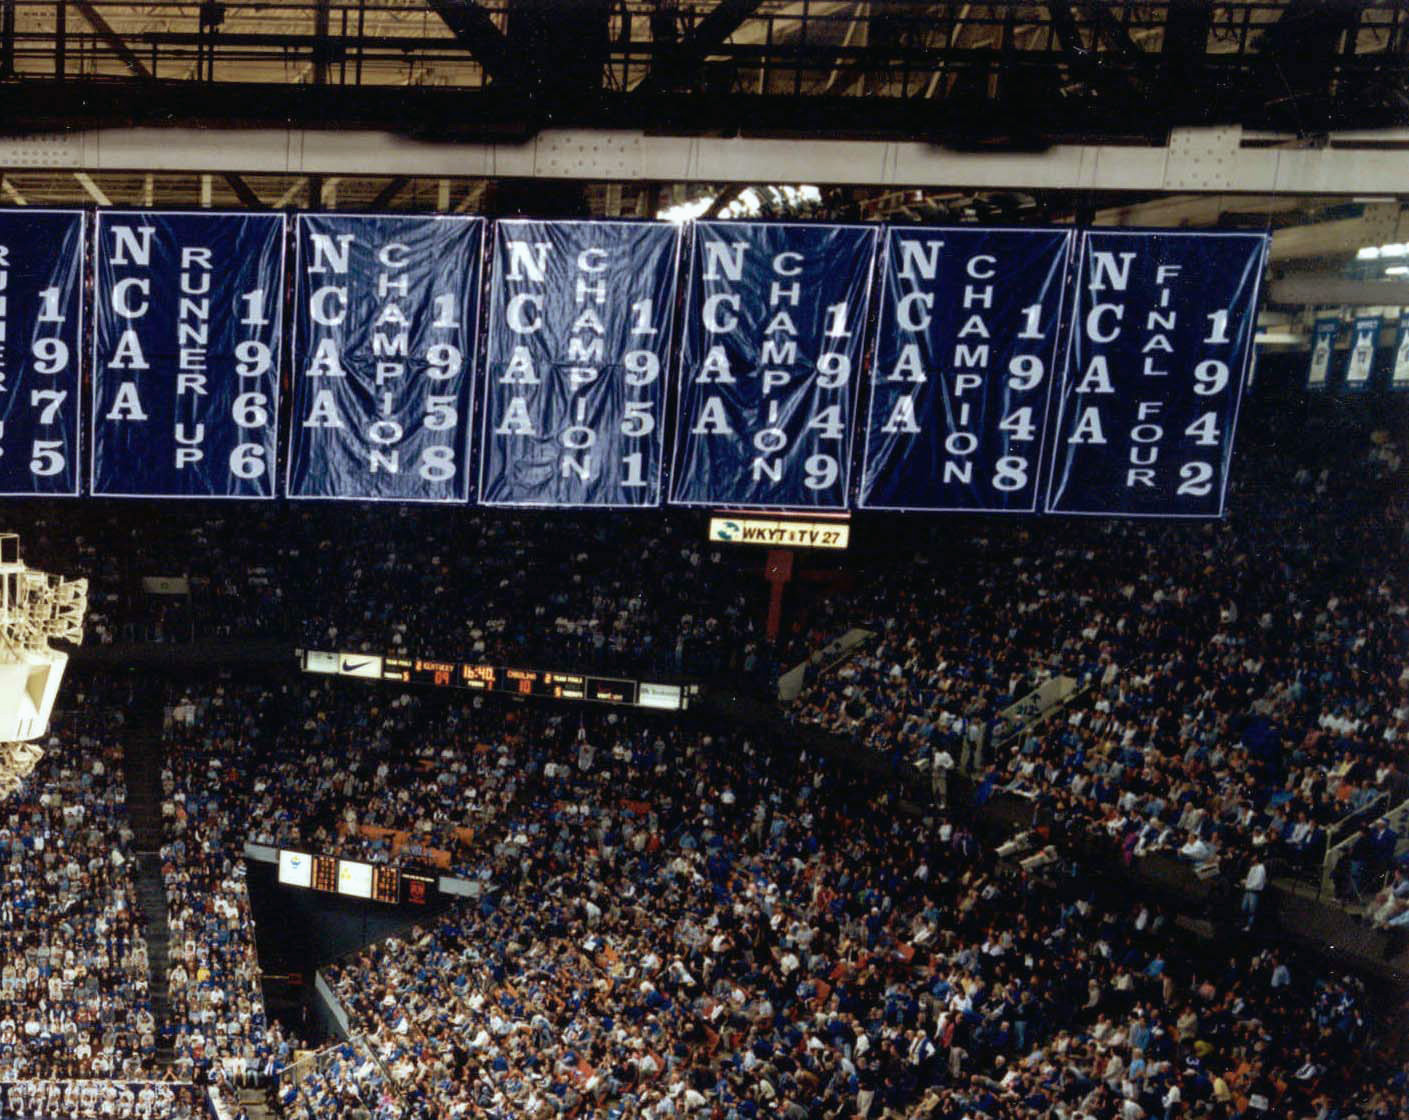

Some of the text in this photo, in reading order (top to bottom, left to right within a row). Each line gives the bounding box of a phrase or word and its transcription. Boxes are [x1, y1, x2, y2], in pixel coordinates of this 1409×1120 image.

[29, 287, 69, 476] 1975
[106, 226, 155, 421] NCAA
[174, 247, 212, 468] RUNNER UP
[228, 290, 272, 479] 1966
[303, 234, 354, 428] NCAA
[368, 244, 409, 474] CHAMPION
[419, 294, 463, 482] 1958
[496, 241, 552, 435] NCAA
[561, 248, 609, 480] CHAMPION
[621, 299, 660, 487] 1951
[692, 241, 750, 434] NCAA
[752, 252, 805, 483] CHAMPION
[803, 304, 852, 490] 1949
[881, 241, 944, 434] NCAA
[943, 255, 997, 484] CHAMPION
[990, 307, 1046, 491] 1948
[1068, 251, 1137, 444] NCAA
[1126, 265, 1179, 488] FINAL FOUR
[1176, 309, 1230, 496] 1942
[822, 531, 840, 545] 27
